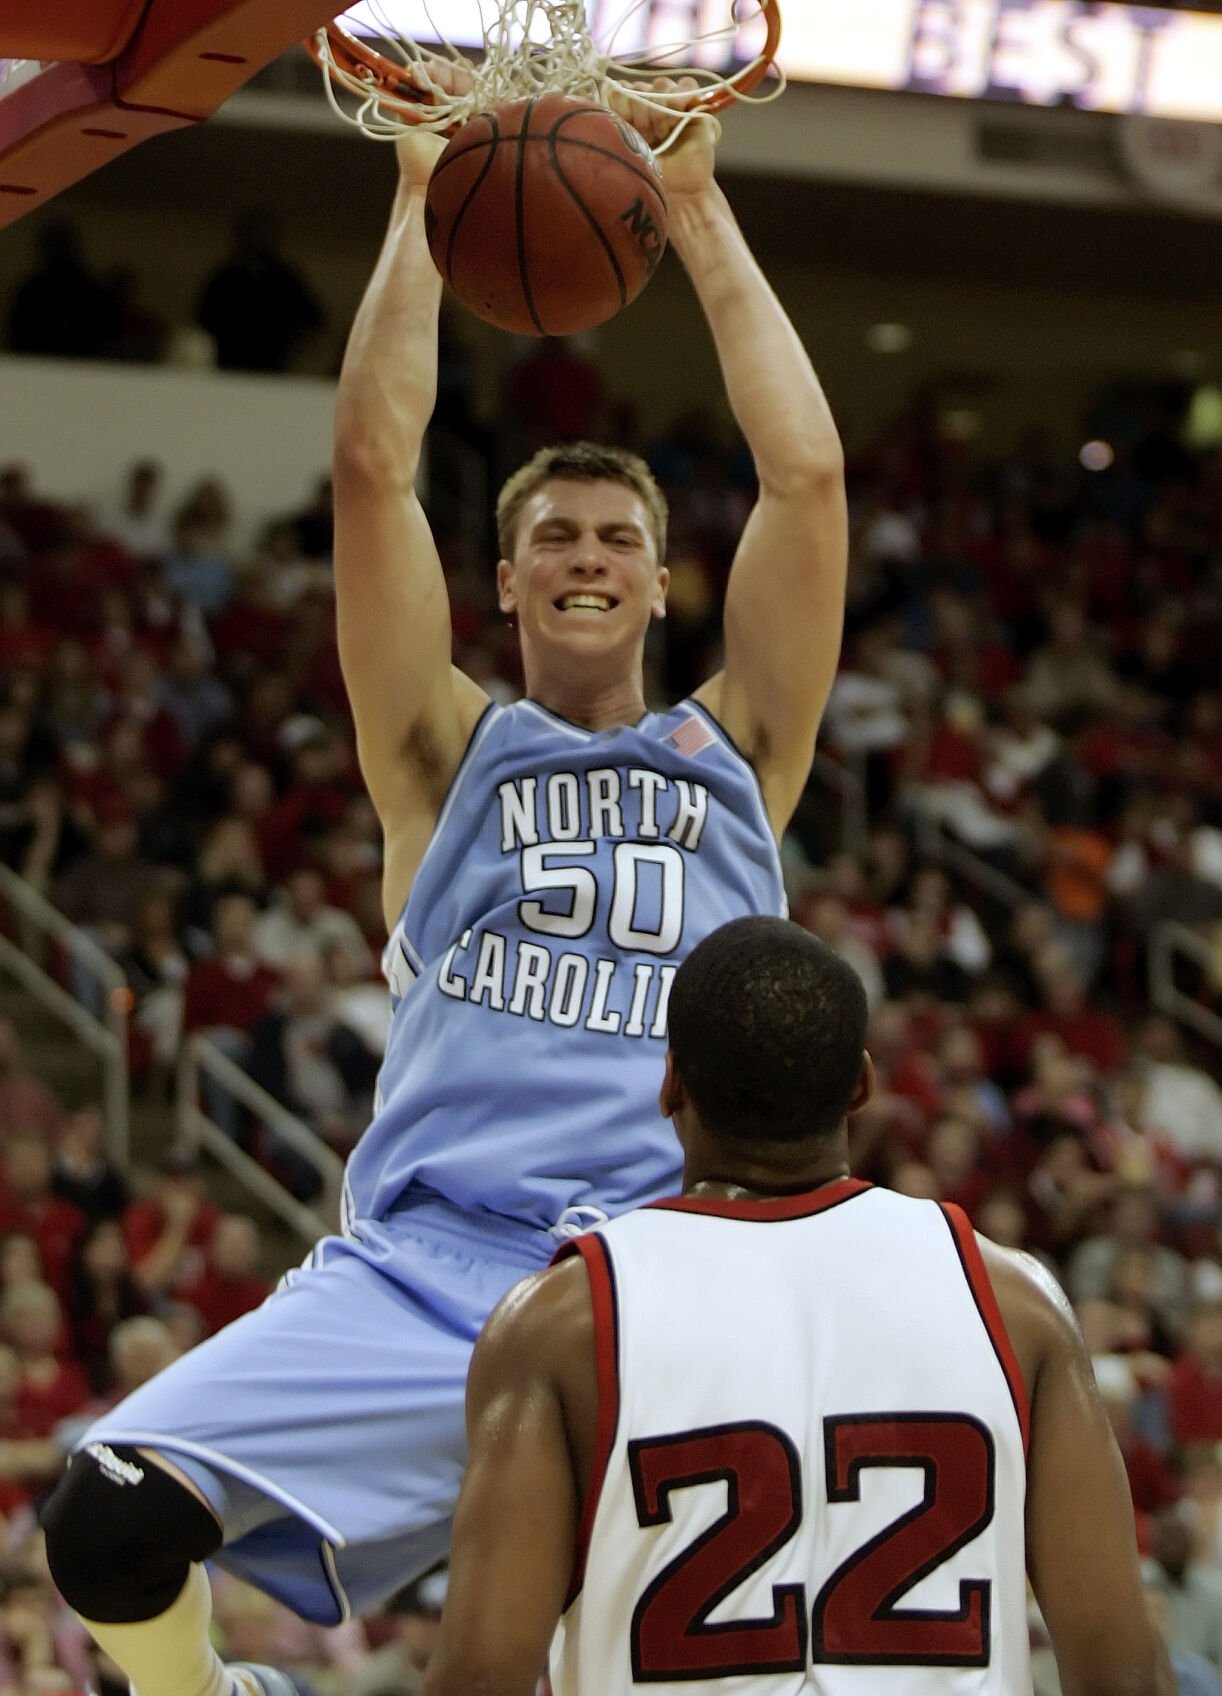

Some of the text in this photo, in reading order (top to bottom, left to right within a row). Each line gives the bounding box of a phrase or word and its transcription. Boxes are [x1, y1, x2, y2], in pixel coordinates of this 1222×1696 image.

[906, 0, 1182, 114] BEST
[498, 766, 709, 853] NORTH
[518, 839, 685, 955] 50
[628, 1411, 996, 1683] 22
